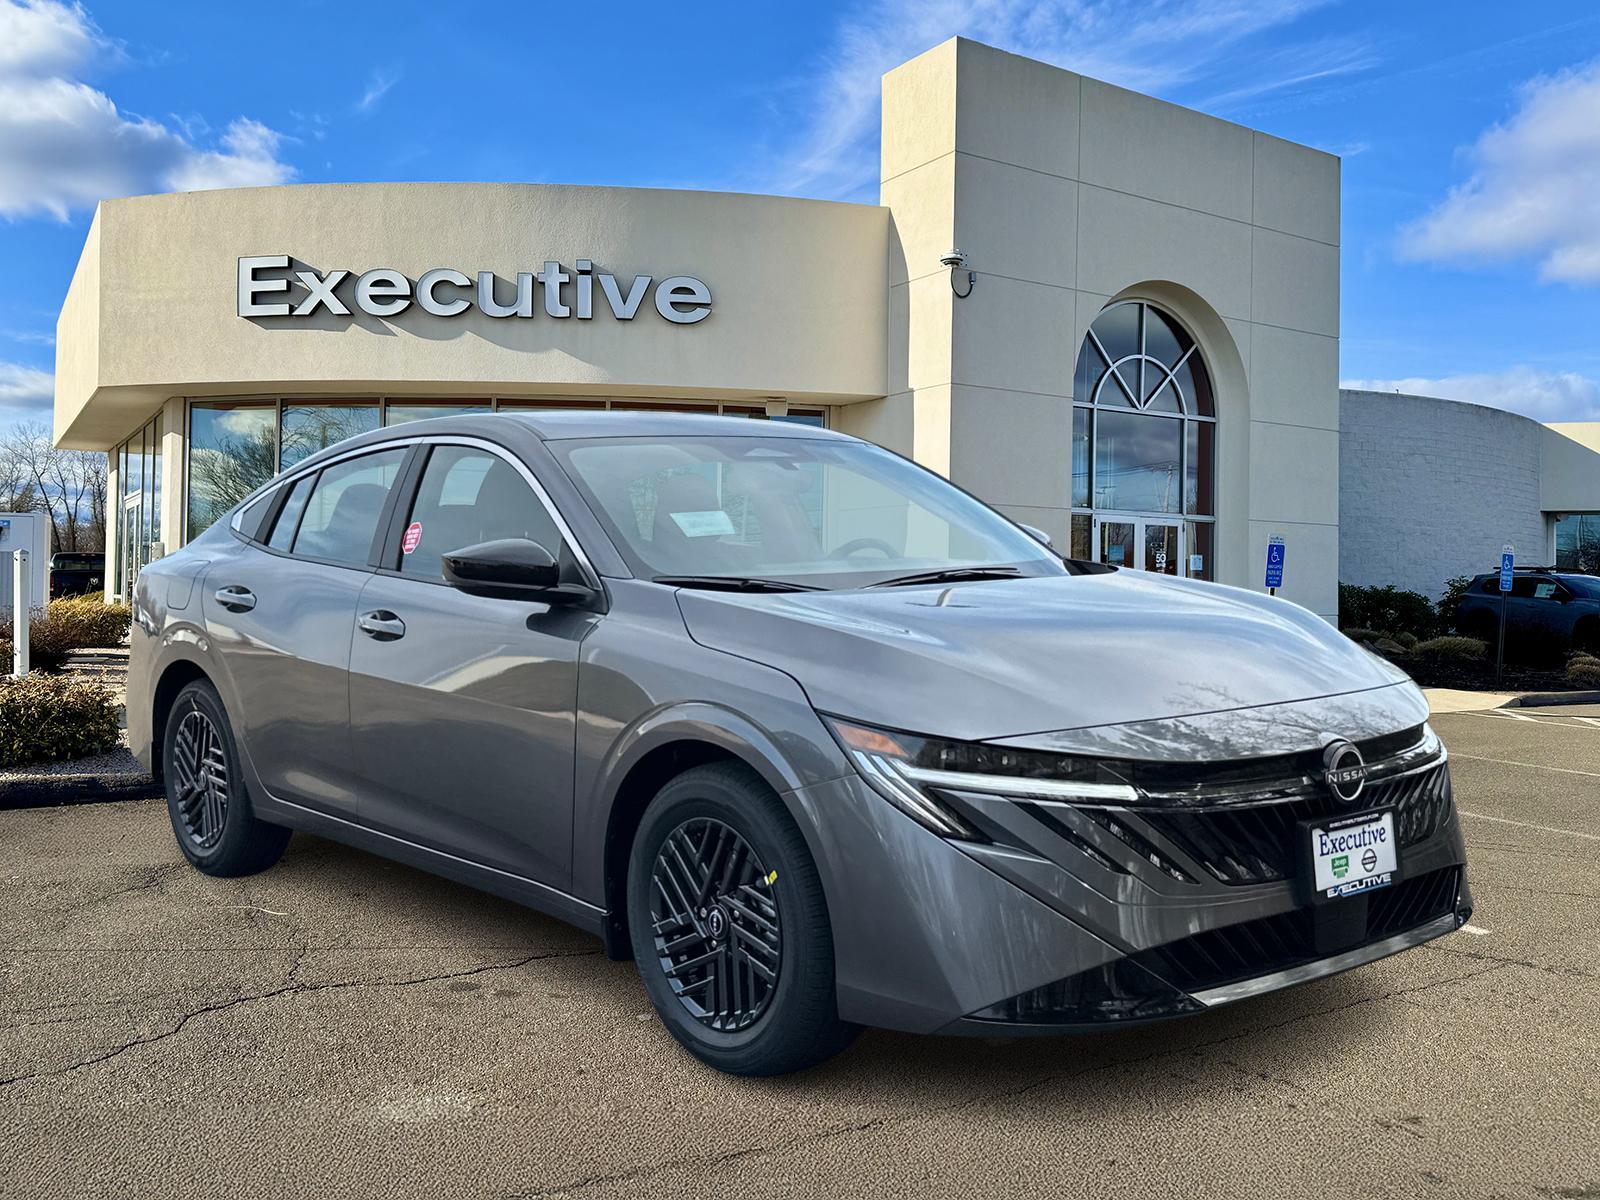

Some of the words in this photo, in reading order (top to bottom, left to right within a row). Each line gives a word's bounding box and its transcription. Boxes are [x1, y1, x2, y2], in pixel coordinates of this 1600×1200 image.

[237, 255, 713, 324] Executive
[1327, 767, 1368, 784] NISSAN
[1318, 824, 1386, 857] Executive
[1333, 858, 1347, 867] Jeep
[1326, 872, 1392, 898] EXECUTIVE
